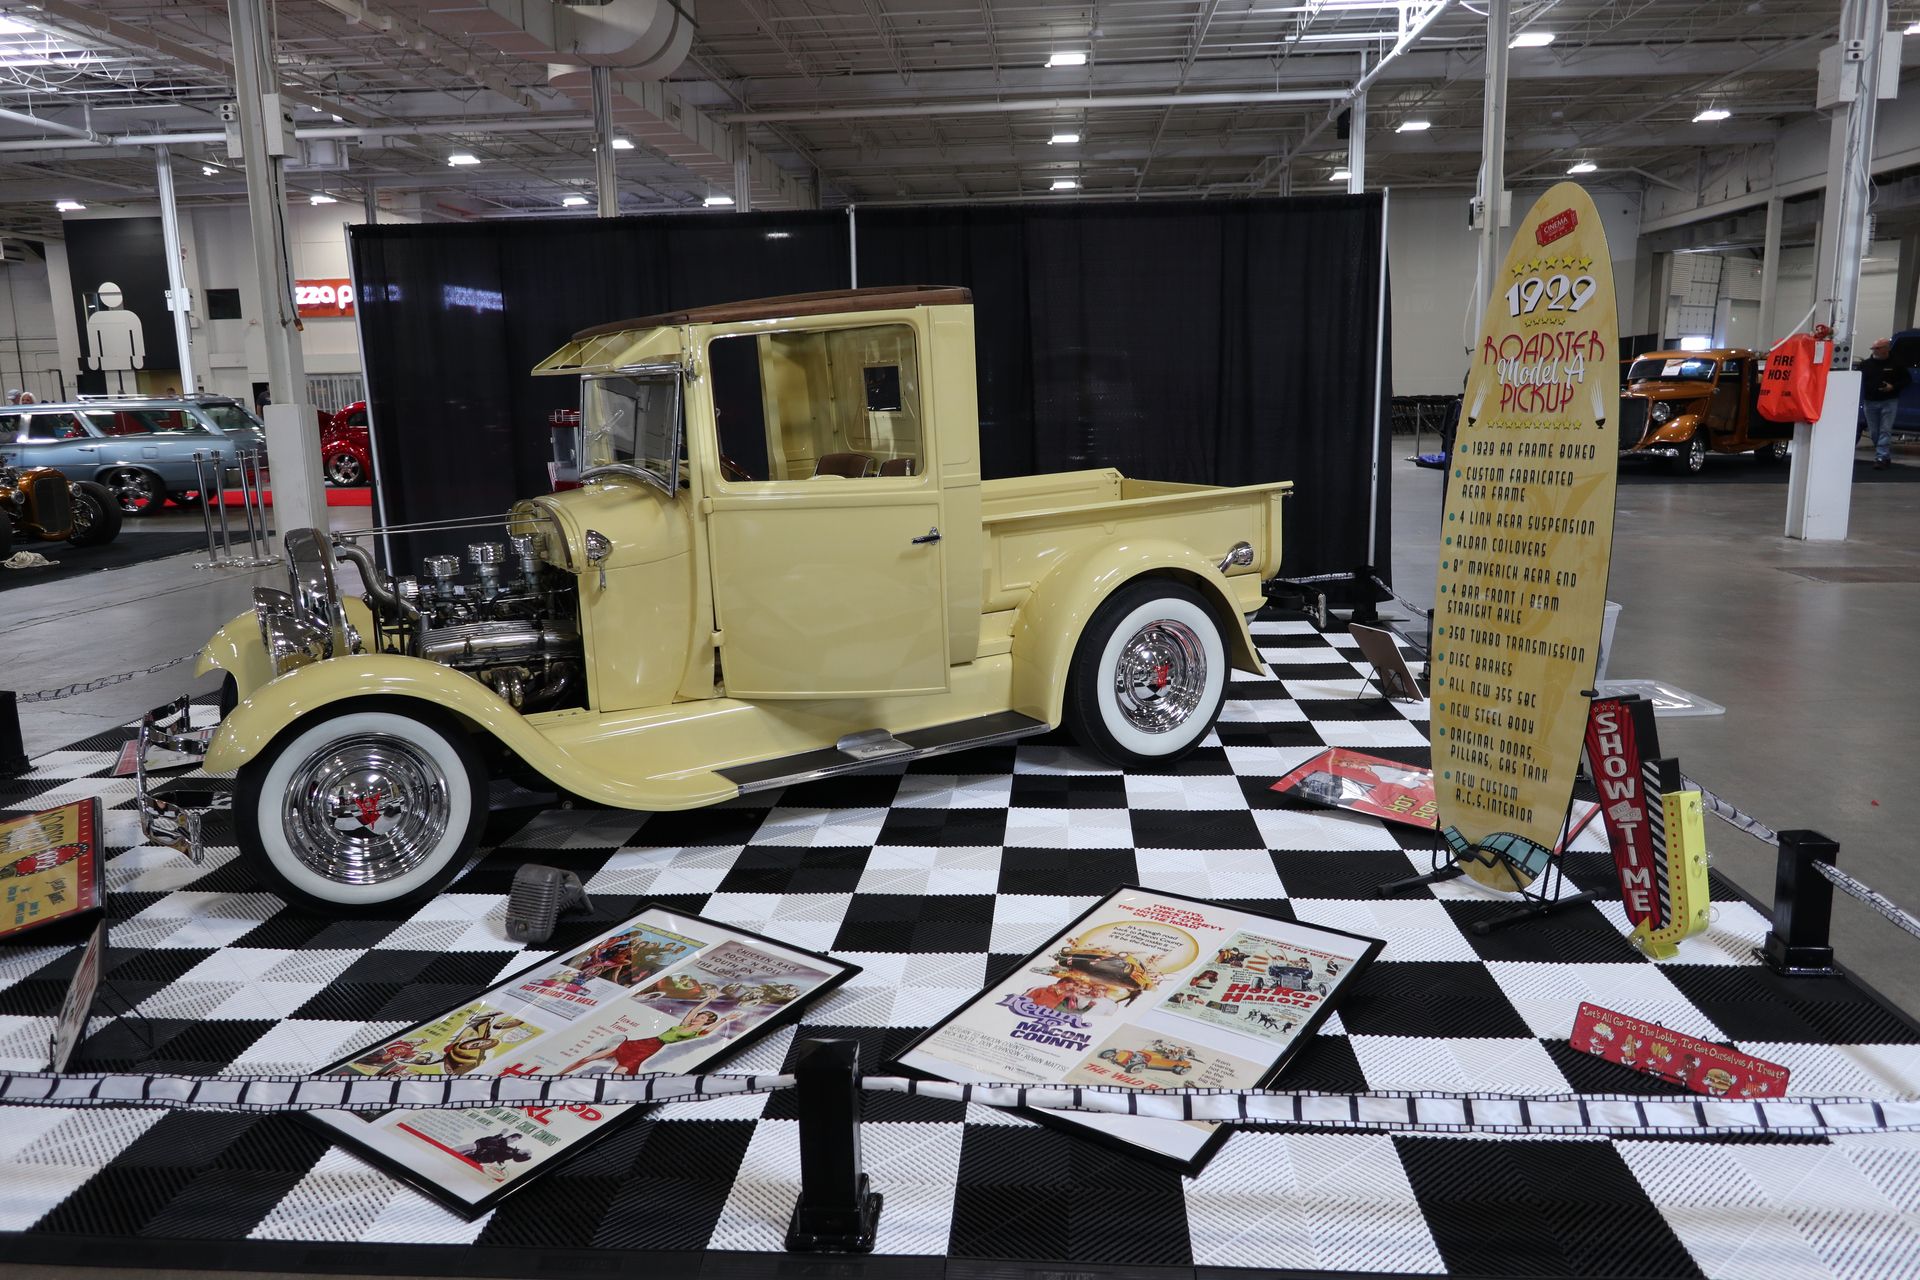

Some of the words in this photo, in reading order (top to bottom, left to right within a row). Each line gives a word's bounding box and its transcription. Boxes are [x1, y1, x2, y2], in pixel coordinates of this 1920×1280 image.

[1543, 216, 1569, 233] CINEMA
[1505, 274, 1597, 317] 1929
[1484, 330, 1605, 365] ROADSTER
[1498, 356, 1560, 388] Model
[1564, 352, 1585, 390] A
[1773, 354, 1795, 366] FIRE
[1768, 369, 1792, 381] HOS
[1500, 383, 1575, 413] PICKUP
[1472, 441, 1495, 456] 1929
[1500, 442, 1513, 457] AA
[1518, 442, 1554, 459] FRAME
[1559, 444, 1596, 460] BOXED
[1466, 466, 1504, 481] CUSTOM
[1510, 468, 1574, 487] FABRICATED
[1462, 484, 1486, 499] REAR
[1491, 486, 1526, 502] FRAME
[1459, 510, 1465, 525] 4
[1470, 511, 1491, 526] LINK
[1496, 513, 1523, 530] REAR
[1528, 515, 1596, 536] SUSPENSION
[1456, 534, 1487, 551] ALDAN
[1492, 537, 1547, 558] COILOVERS
[1468, 560, 1518, 580] MAVERICK
[1524, 567, 1550, 585] REAR
[1556, 571, 1577, 588] END
[1451, 583, 1457, 598] 4
[1461, 584, 1480, 600] BAR
[1485, 586, 1516, 603] FRONT
[1530, 593, 1560, 612] BEAM
[1447, 600, 1492, 619] STRAIGHT
[1496, 606, 1522, 625] AXLE
[1448, 625, 1466, 642] 350
[1470, 628, 1501, 647] TURBO
[1506, 635, 1585, 663] TRANSMISSION
[1449, 651, 1471, 668] DISC
[1475, 656, 1513, 677] BRAKES
[1449, 676, 1465, 693] ALL
[1470, 681, 1491, 698] NEW
[1495, 686, 1512, 703] 355
[1517, 691, 1537, 708] SBC
[1450, 702, 1470, 718] NEW
[1475, 707, 1502, 727] STEEL
[1507, 715, 1535, 735] BODY
[1450, 726, 1494, 751] ORIGINAL
[1596, 711, 1636, 801] SHOW
[1498, 757, 1517, 775] GAS
[1522, 763, 1548, 784] TANK
[1455, 770, 1475, 789] NEW
[1480, 777, 1518, 802] CUSTOM
[1383, 794, 1418, 814] HOT
[1616, 822, 1651, 913] TIME
[1137, 908, 1178, 920] HOTTEST
[1191, 920, 1226, 932] CHEVY
[1153, 908, 1182, 917] CHICK
[1182, 914, 1205, 923] AND
[1169, 919, 1201, 931] ROAD!
[696, 960, 712, 969] THE
[713, 966, 743, 980] LOOSE
[710, 956, 739, 970] YOUTH
[740, 966, 755, 975] ON
[723, 952, 748, 963] ROCK
[760, 964, 782, 976] ROLL
[736, 948, 800, 973] CHICKEN-RACE
[519, 984, 539, 992] HOT
[563, 993, 576, 1001] TO
[575, 996, 599, 1006] HELL
[1220, 993, 1314, 1008] HARLOTS
[1227, 983, 1274, 995] HOT
[1271, 986, 1320, 1002] ROD
[995, 993, 1093, 1029] Return
[1010, 1030, 1091, 1052] COUNTY
[1016, 1021, 1092, 1043] MACON
[1601, 1013, 1612, 1024] All
[1612, 1016, 1624, 1027] Go
[1626, 1020, 1637, 1031] To
[1639, 1024, 1655, 1037] The
[1681, 1038, 1693, 1049] To
[1693, 1043, 1708, 1055] Get
[1709, 1047, 1746, 1067] Ourselves
[1746, 1060, 1754, 1070] A
[1083, 1063, 1111, 1078] THE
[1111, 1072, 1145, 1086] WILD
